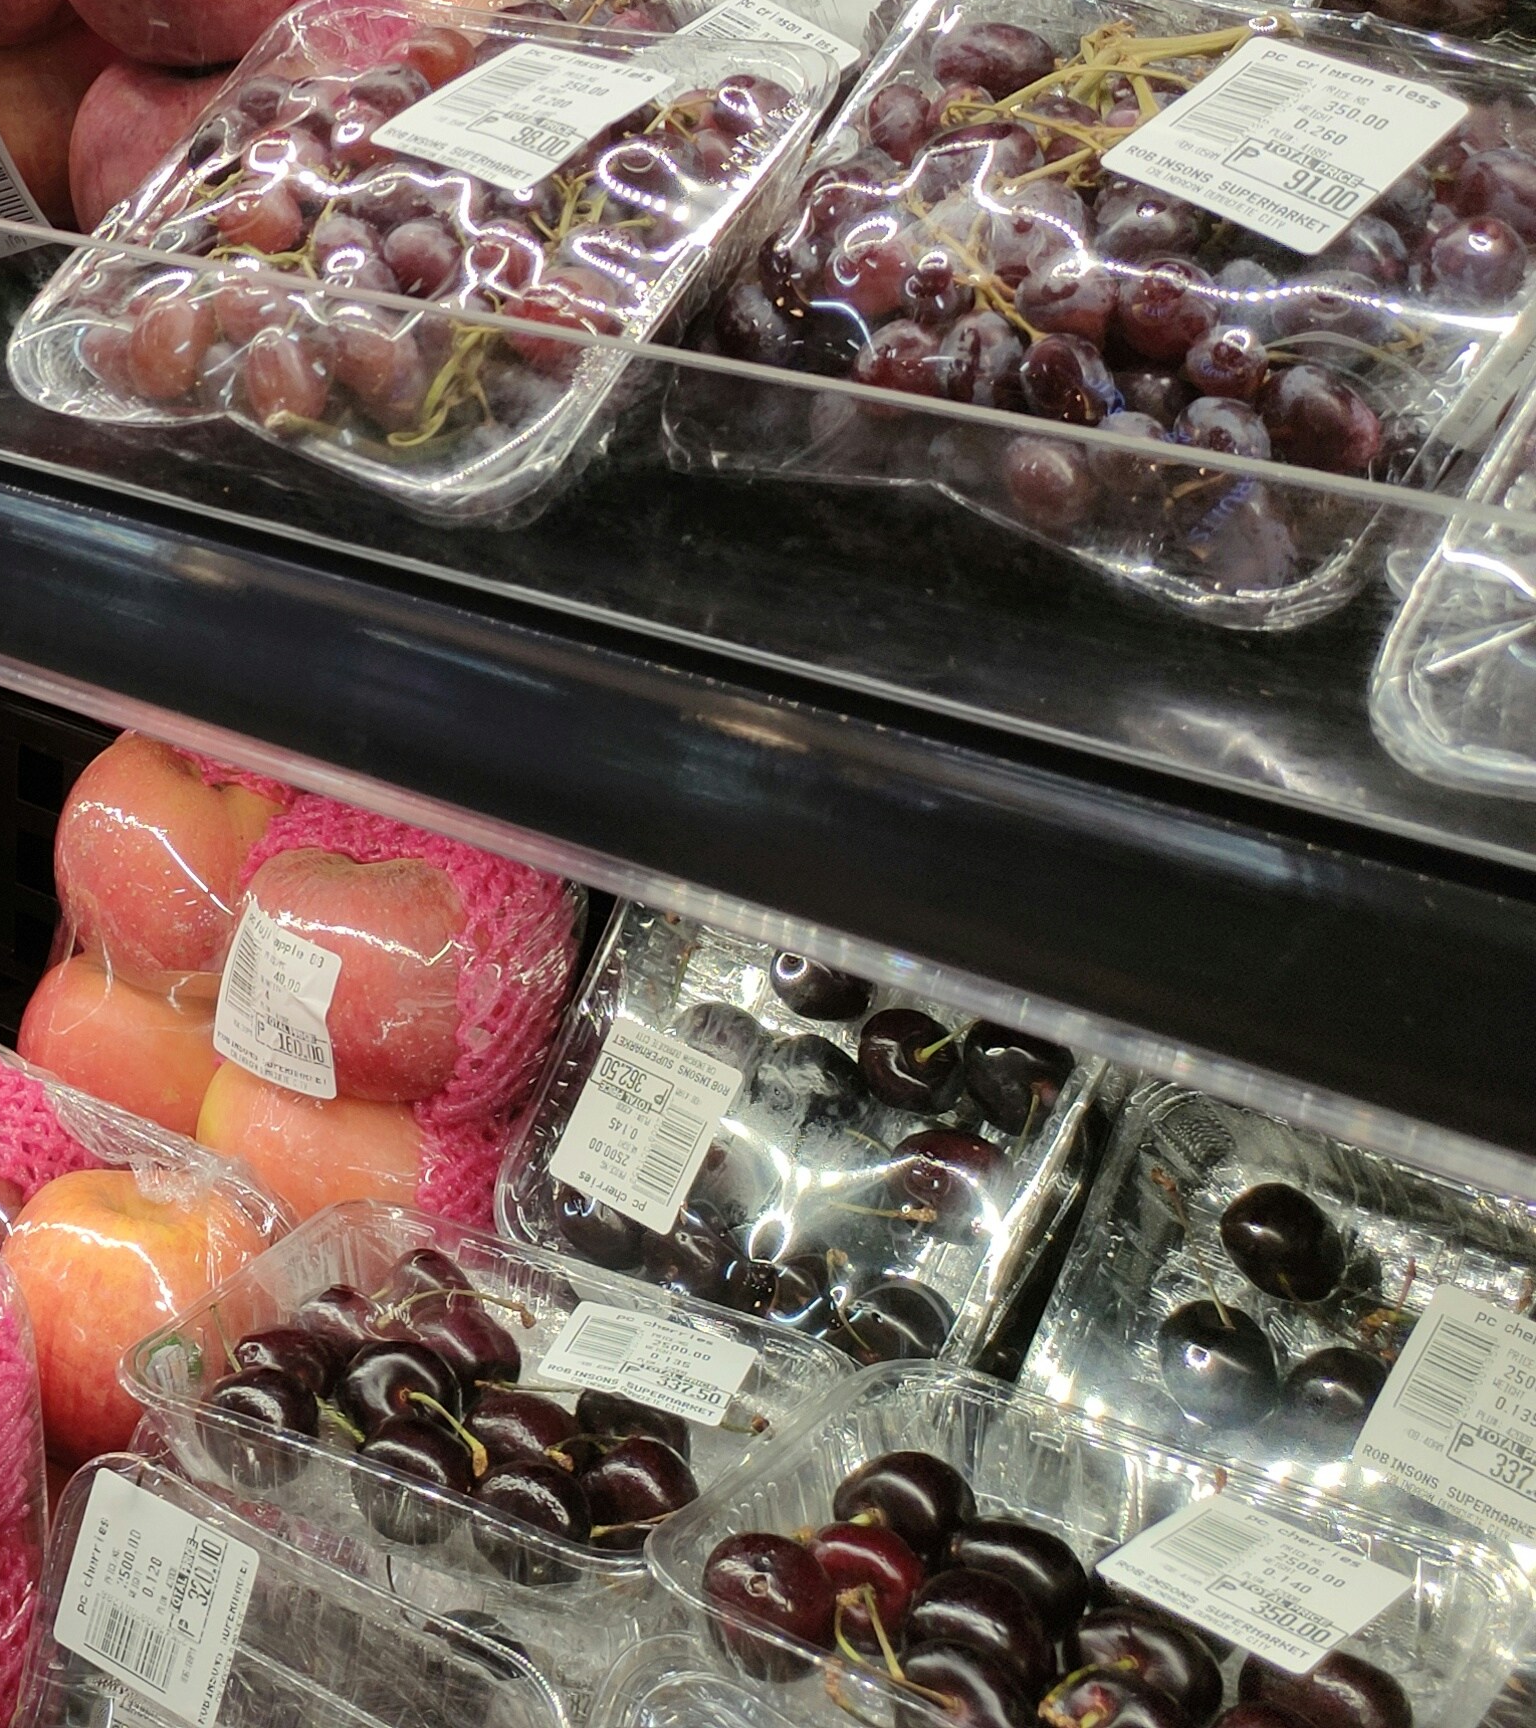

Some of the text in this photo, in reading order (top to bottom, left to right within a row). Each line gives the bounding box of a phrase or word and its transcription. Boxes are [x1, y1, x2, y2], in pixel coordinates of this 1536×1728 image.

[1261, 50, 1441, 110] pc crimson sless
[1293, 118, 1348, 147] 0.260
[1323, 100, 1390, 131] 350.00
[510, 126, 571, 158] 98.00
[1266, 140, 1362, 187] TOTAL PRICE
[1218, 181, 1330, 234] SUPERMARKET
[1284, 170, 1359, 213] 91.00
[613, 1033, 674, 1069] SUPERMARKET
[599, 1056, 647, 1092] 362.50
[609, 1117, 639, 1139] 0.145
[588, 1137, 630, 1167] 2500.00
[578, 1170, 647, 1212] pc cherries
[616, 1314, 714, 1346] pc cherries
[1475, 1311, 1498, 1327] pc
[650, 1352, 692, 1369] 0.135
[652, 1340, 712, 1362] 2500.00
[626, 1381, 716, 1417] SUPERMARKET
[655, 1374, 723, 1405] 337.50
[1244, 1513, 1362, 1569] pc cherries
[1262, 1565, 1312, 1594] 0.140
[1271, 1549, 1347, 1589] 2500.00
[77, 1594, 88, 1616] pc
[1250, 1600, 1332, 1644] 350.00
[1205, 1604, 1312, 1660] SUPERMARKET
